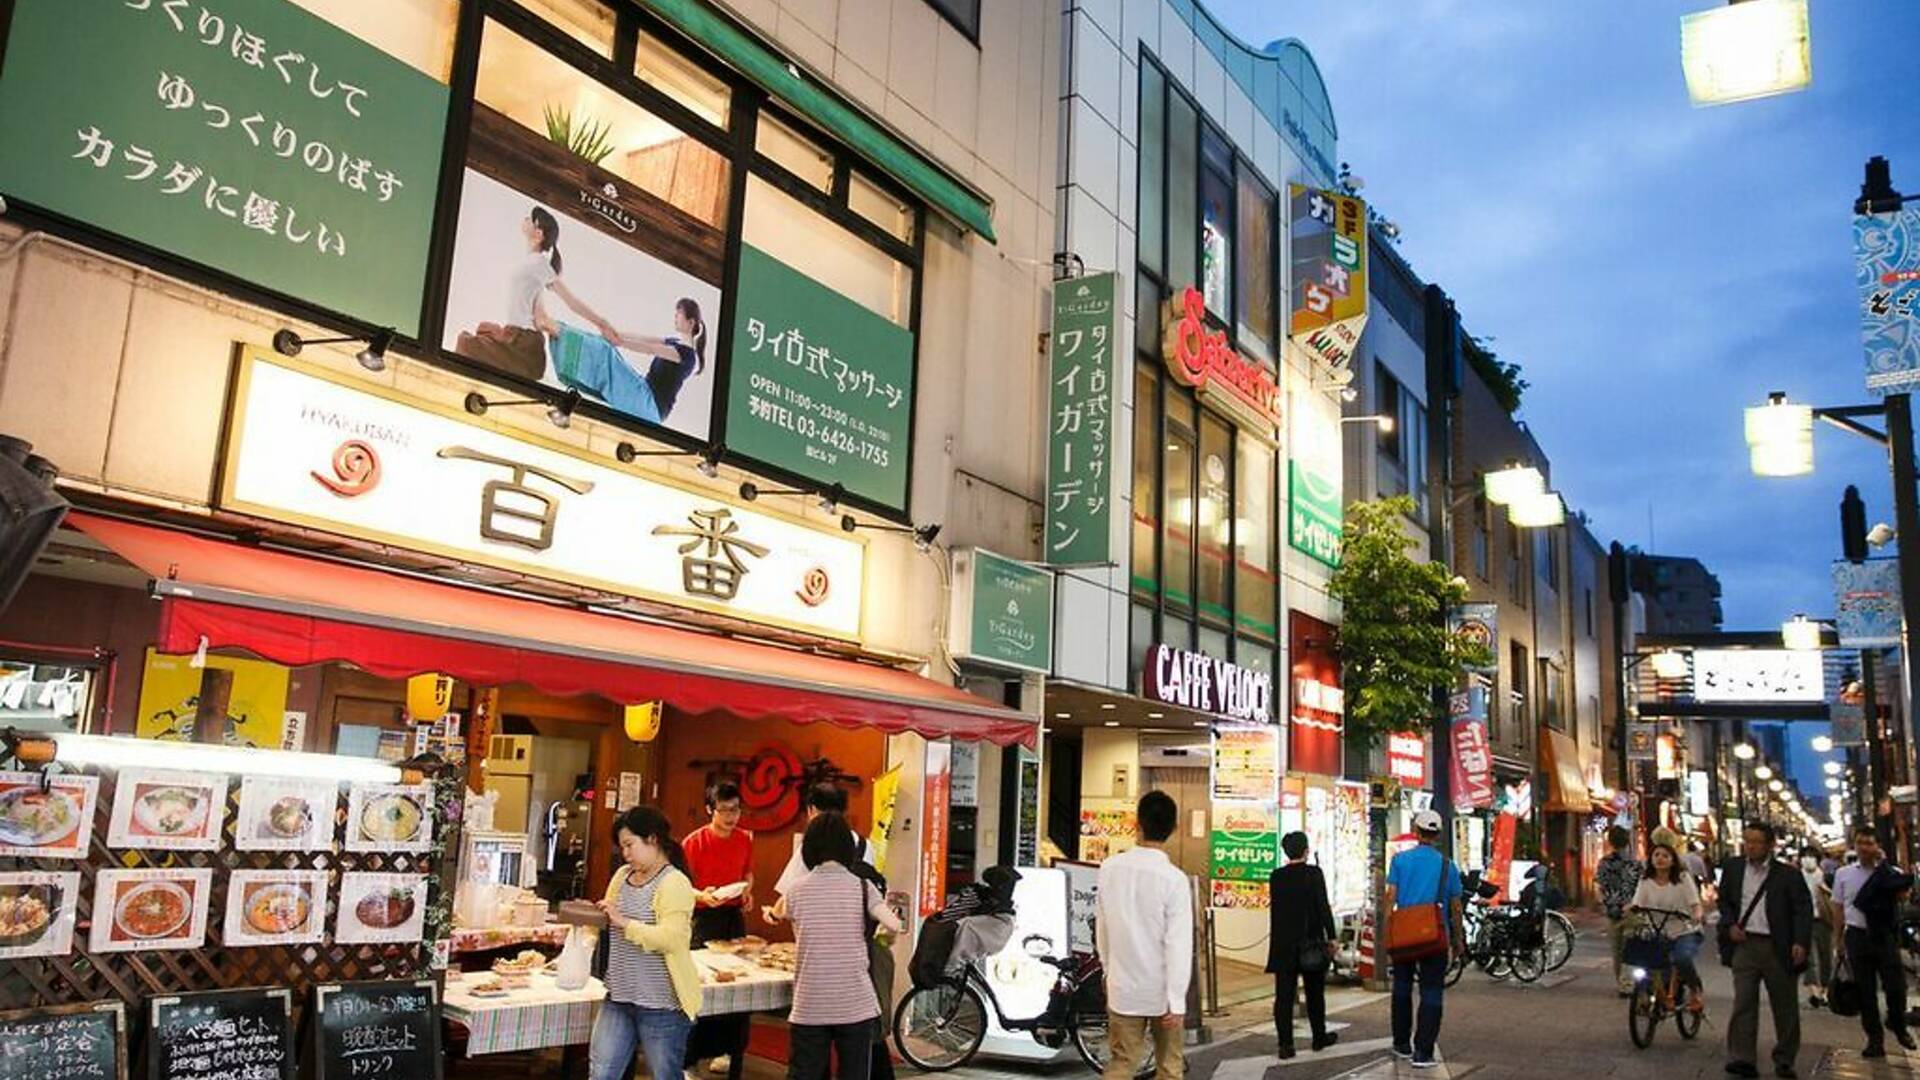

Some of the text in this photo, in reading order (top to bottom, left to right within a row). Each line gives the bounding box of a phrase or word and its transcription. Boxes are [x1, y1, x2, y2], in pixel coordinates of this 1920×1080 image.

[157, 71, 403, 201] ゆっくりのばす
[72, 125, 346, 257] カラダに優しい
[748, 318, 903, 408] タイ古式マッサージ
[751, 373, 781, 398] OPEN
[749, 394, 889, 467] 予約TEL 03-6426-1755
[1053, 330, 1083, 551] ワイガーデン
[1086, 325, 1109, 515] タイ古式マッサージ
[1156, 643, 1211, 711] CAFFE
[1214, 846, 1275, 863] サイゼリヤ
